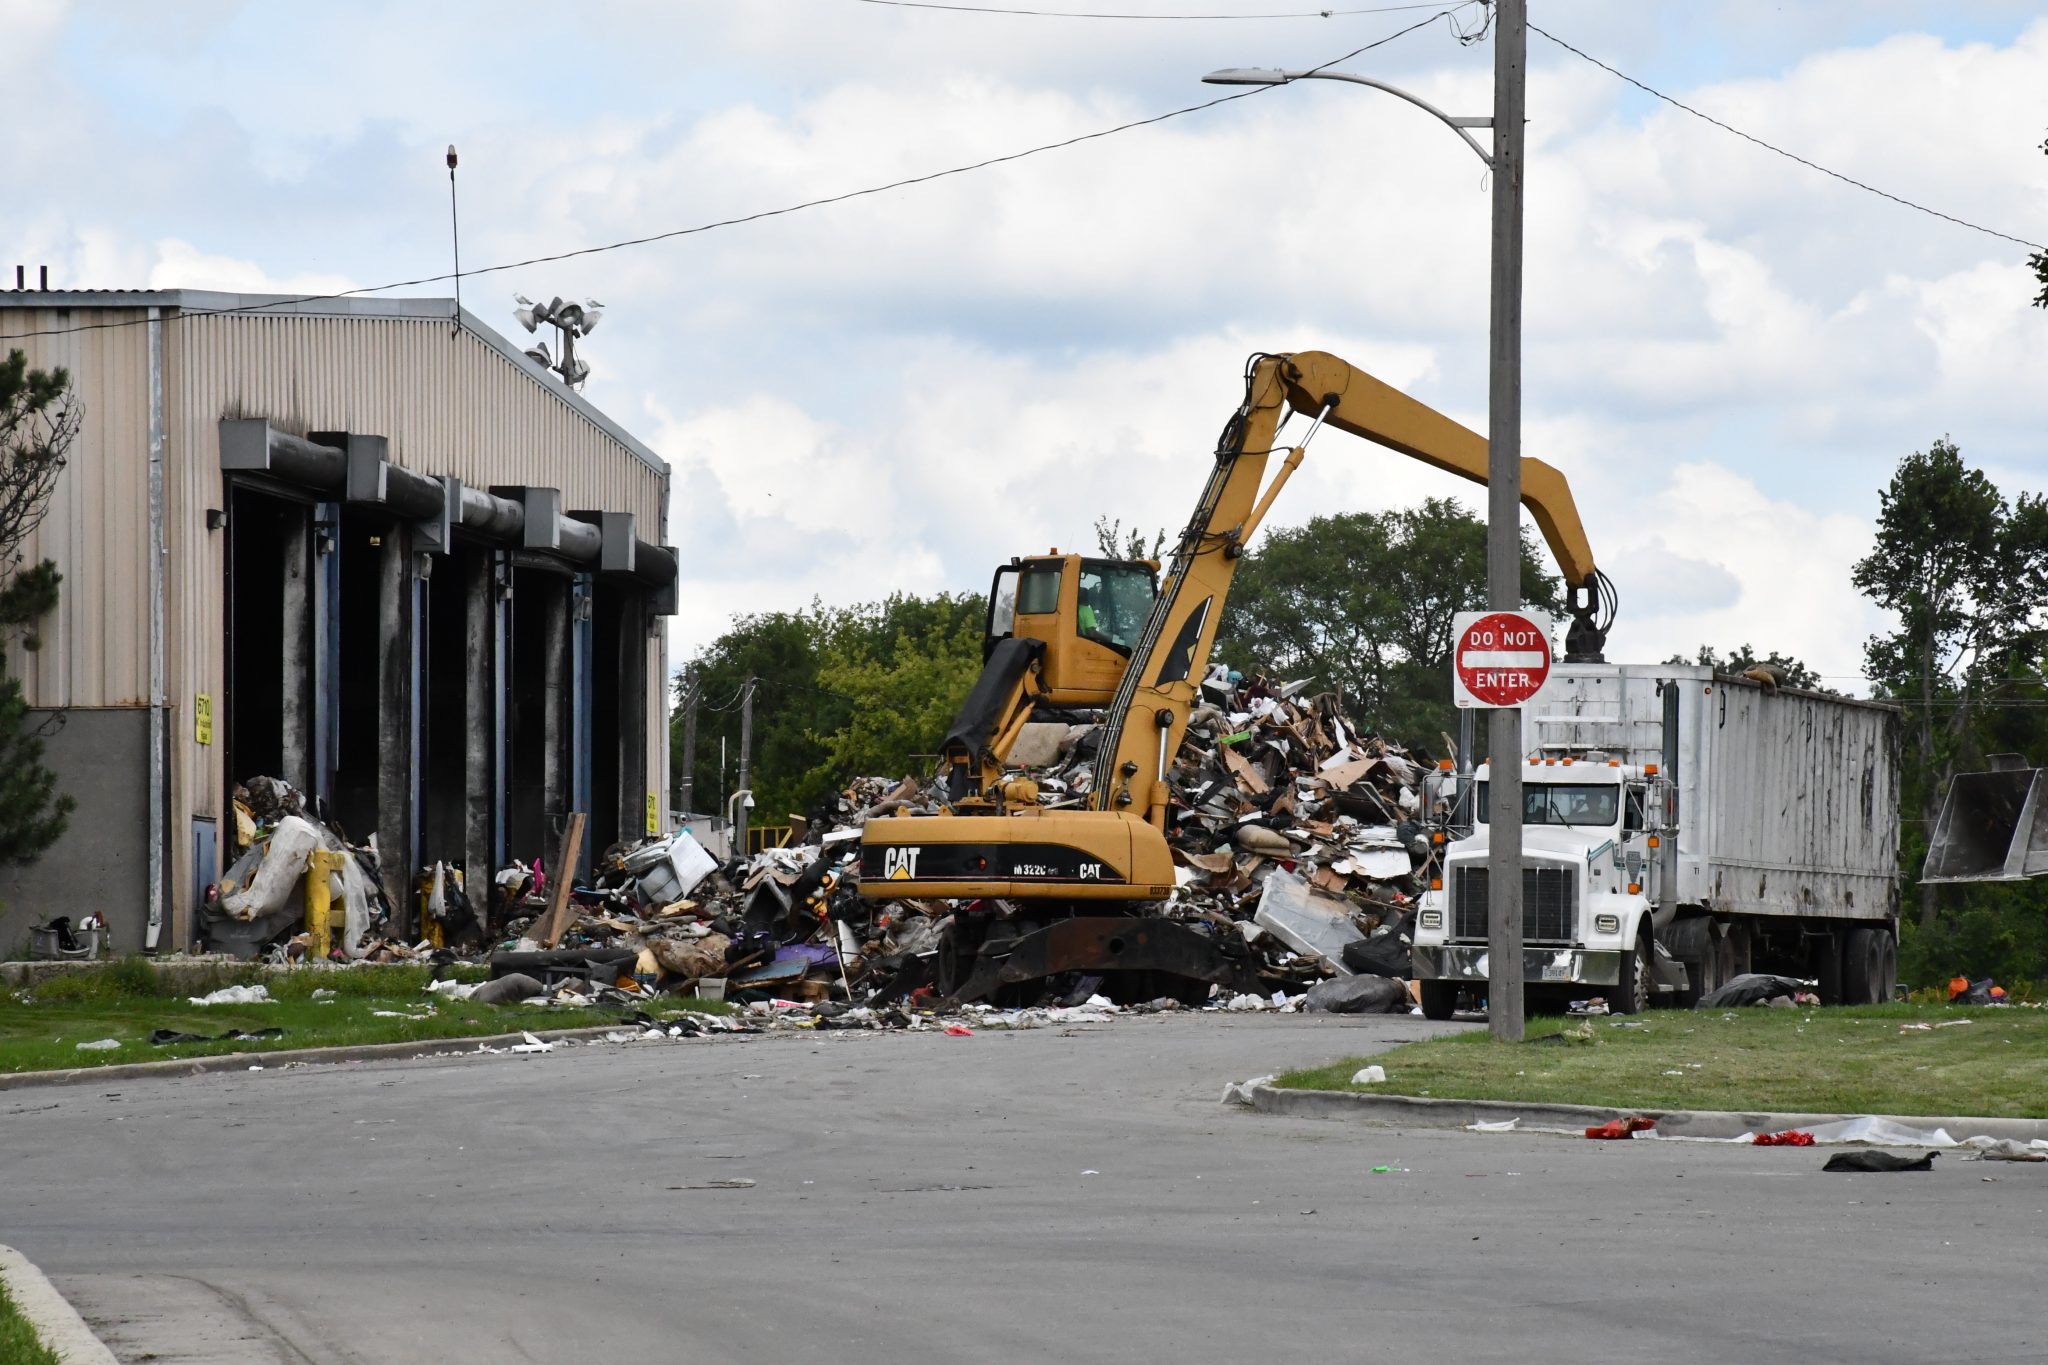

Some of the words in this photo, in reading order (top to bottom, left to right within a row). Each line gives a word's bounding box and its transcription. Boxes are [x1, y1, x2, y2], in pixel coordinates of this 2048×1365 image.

[1471, 632, 1494, 646] DO
[1503, 632, 1537, 646] NOT
[1476, 673, 1529, 688] ENTER
[884, 847, 921, 880] CAT
[1079, 863, 1102, 880] CAT
